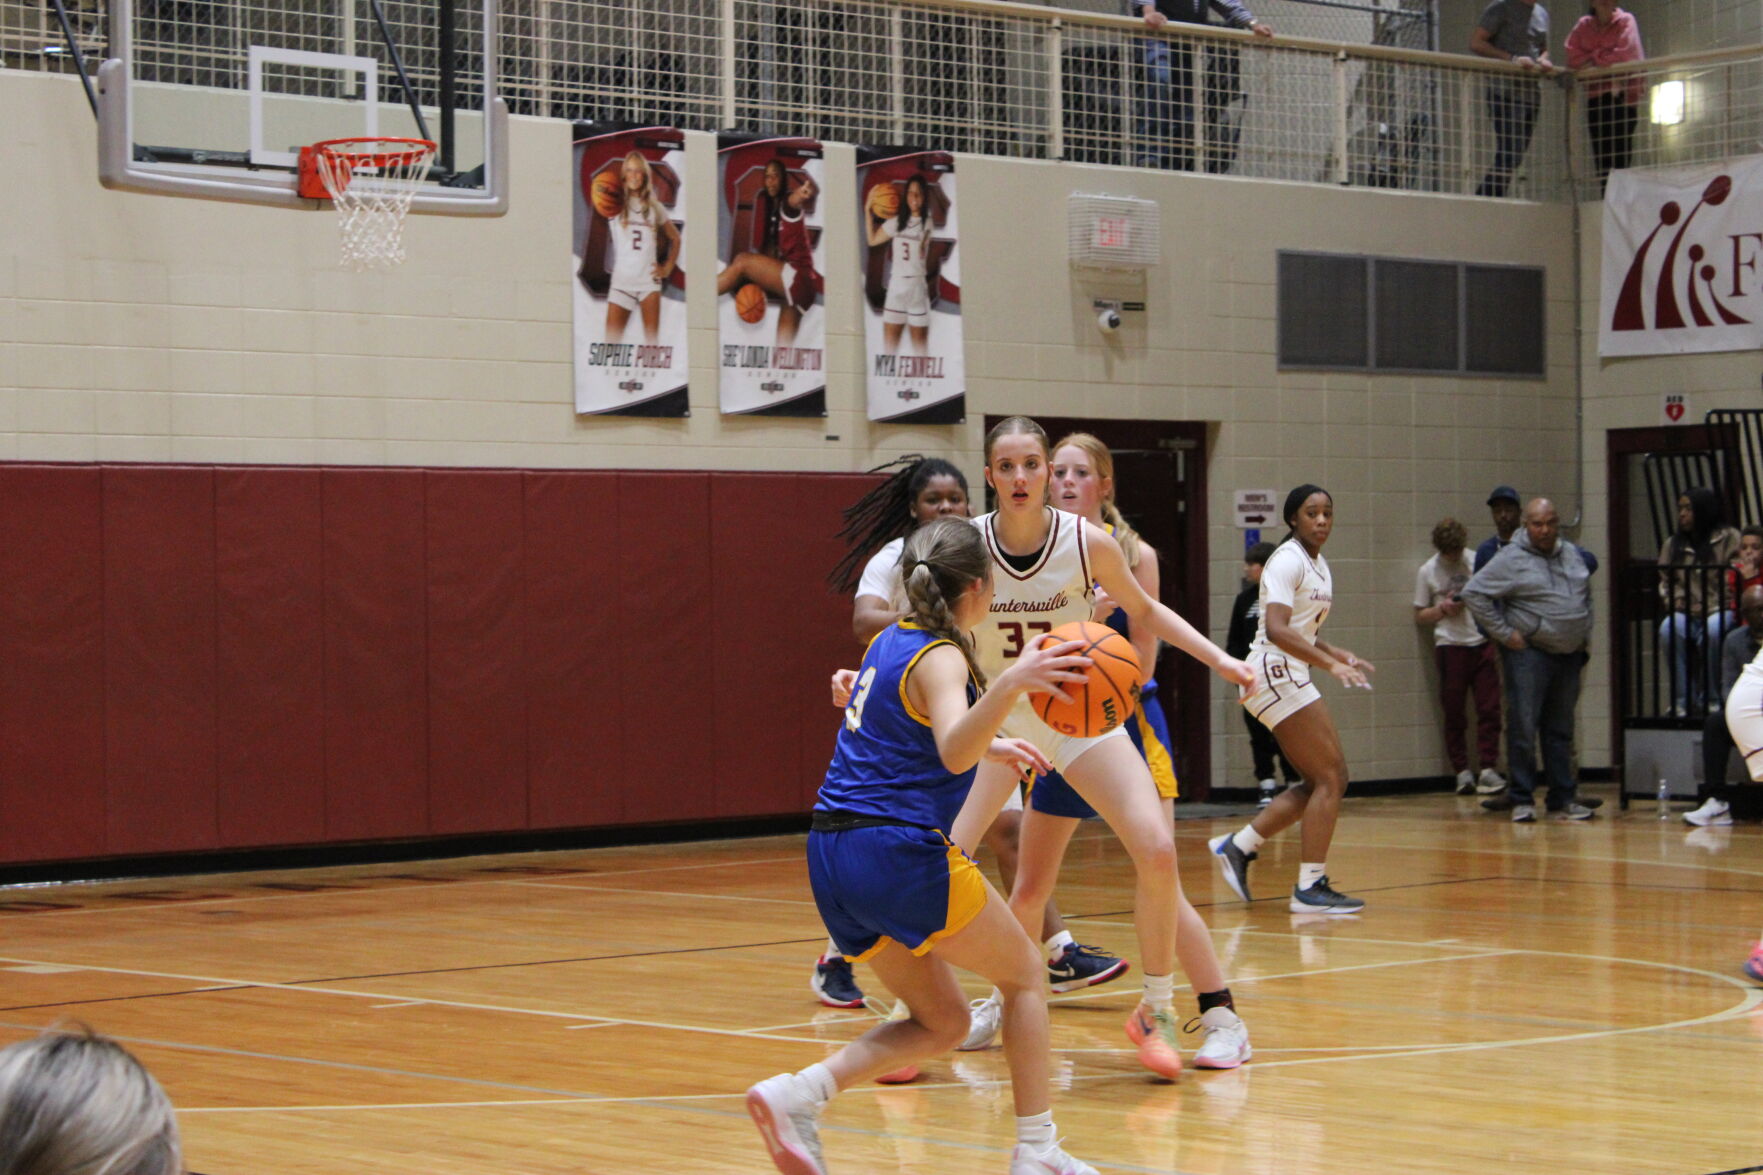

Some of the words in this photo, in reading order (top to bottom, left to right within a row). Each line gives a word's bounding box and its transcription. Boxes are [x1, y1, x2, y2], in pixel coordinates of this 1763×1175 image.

[632, 229, 642, 250] 2
[901, 241, 910, 261] 3
[588, 342, 634, 367] SOPHIE
[875, 355, 896, 377] MYA
[898, 355, 944, 379] FENNELL
[989, 590, 1069, 613] untersville
[1271, 664, 1284, 679] G
